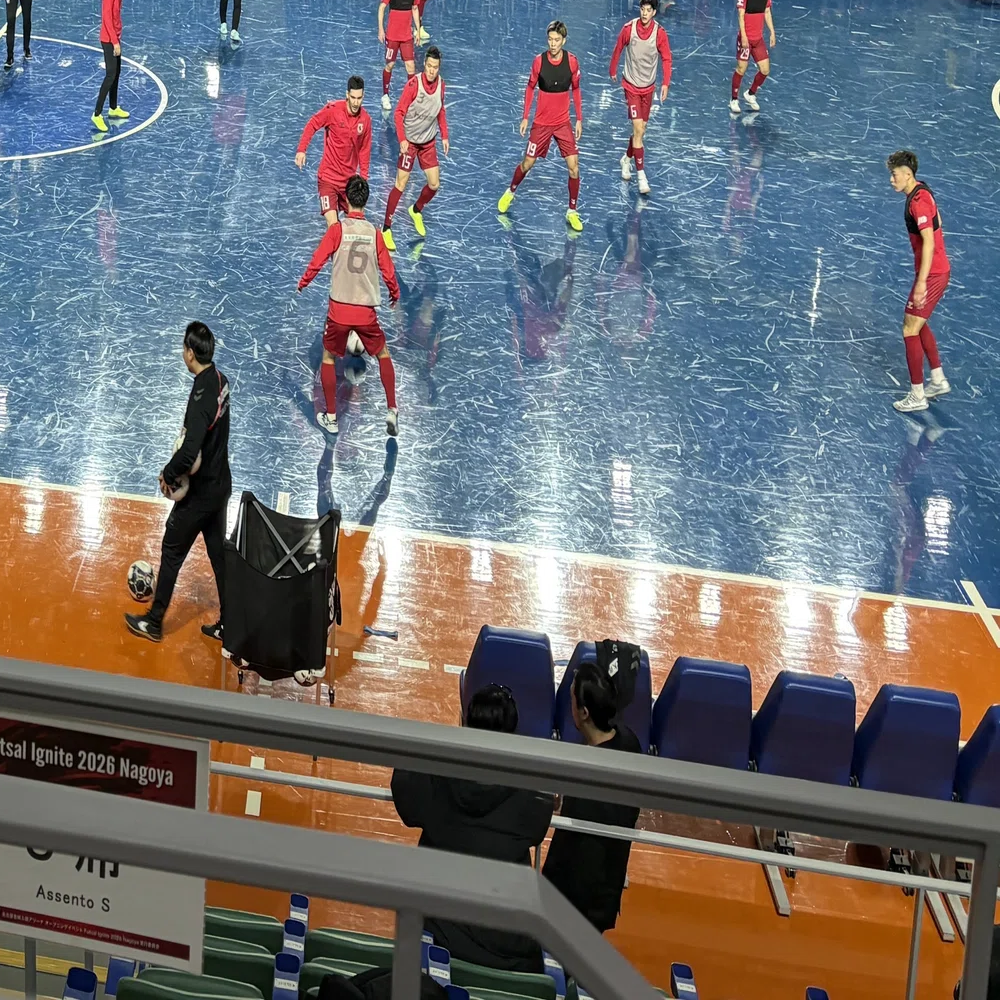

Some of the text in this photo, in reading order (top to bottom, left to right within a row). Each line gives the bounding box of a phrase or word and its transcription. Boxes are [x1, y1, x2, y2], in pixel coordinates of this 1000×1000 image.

[527, 141, 537, 156] 19
[402, 154, 411, 169] 15
[320, 196, 330, 210] 18
[347, 240, 370, 274] 6
[31, 742, 73, 768] Ignite
[77, 751, 115, 775] 2026
[119, 758, 174, 788] Nagoya
[36, 885, 110, 912] Assento S
